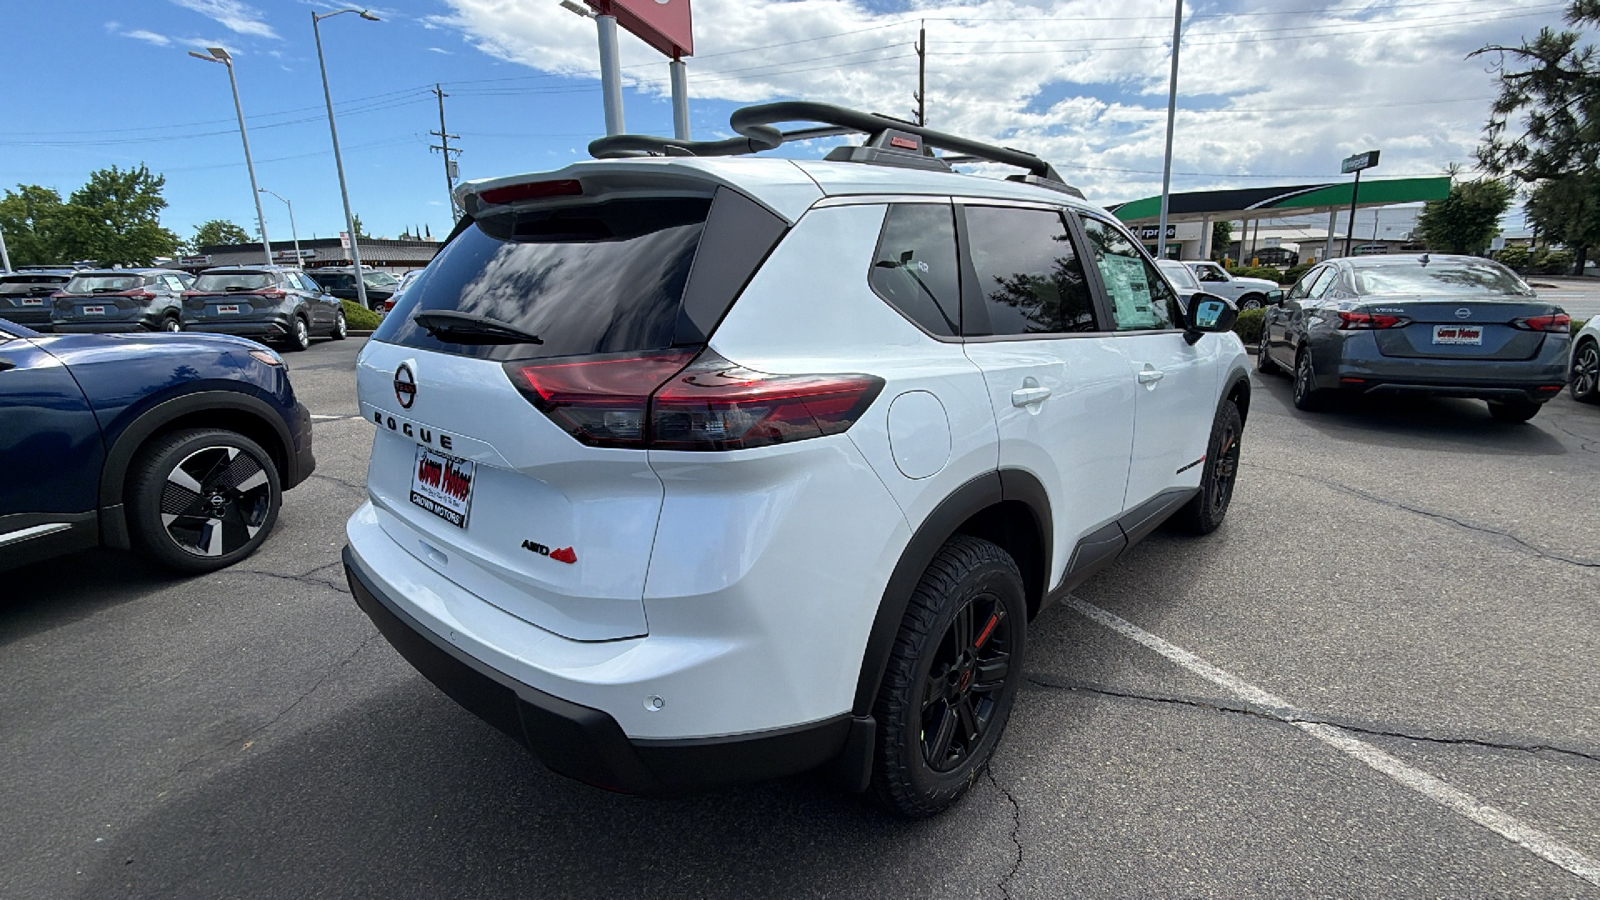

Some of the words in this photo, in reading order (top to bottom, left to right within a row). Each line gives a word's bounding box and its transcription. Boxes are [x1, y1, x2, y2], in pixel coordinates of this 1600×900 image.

[374, 411, 453, 450] ROGUE
[441, 458, 471, 502] Motors
[412, 493, 434, 511] CROWN
[434, 504, 460, 525] MOTORS
[521, 539, 550, 556] AWD
